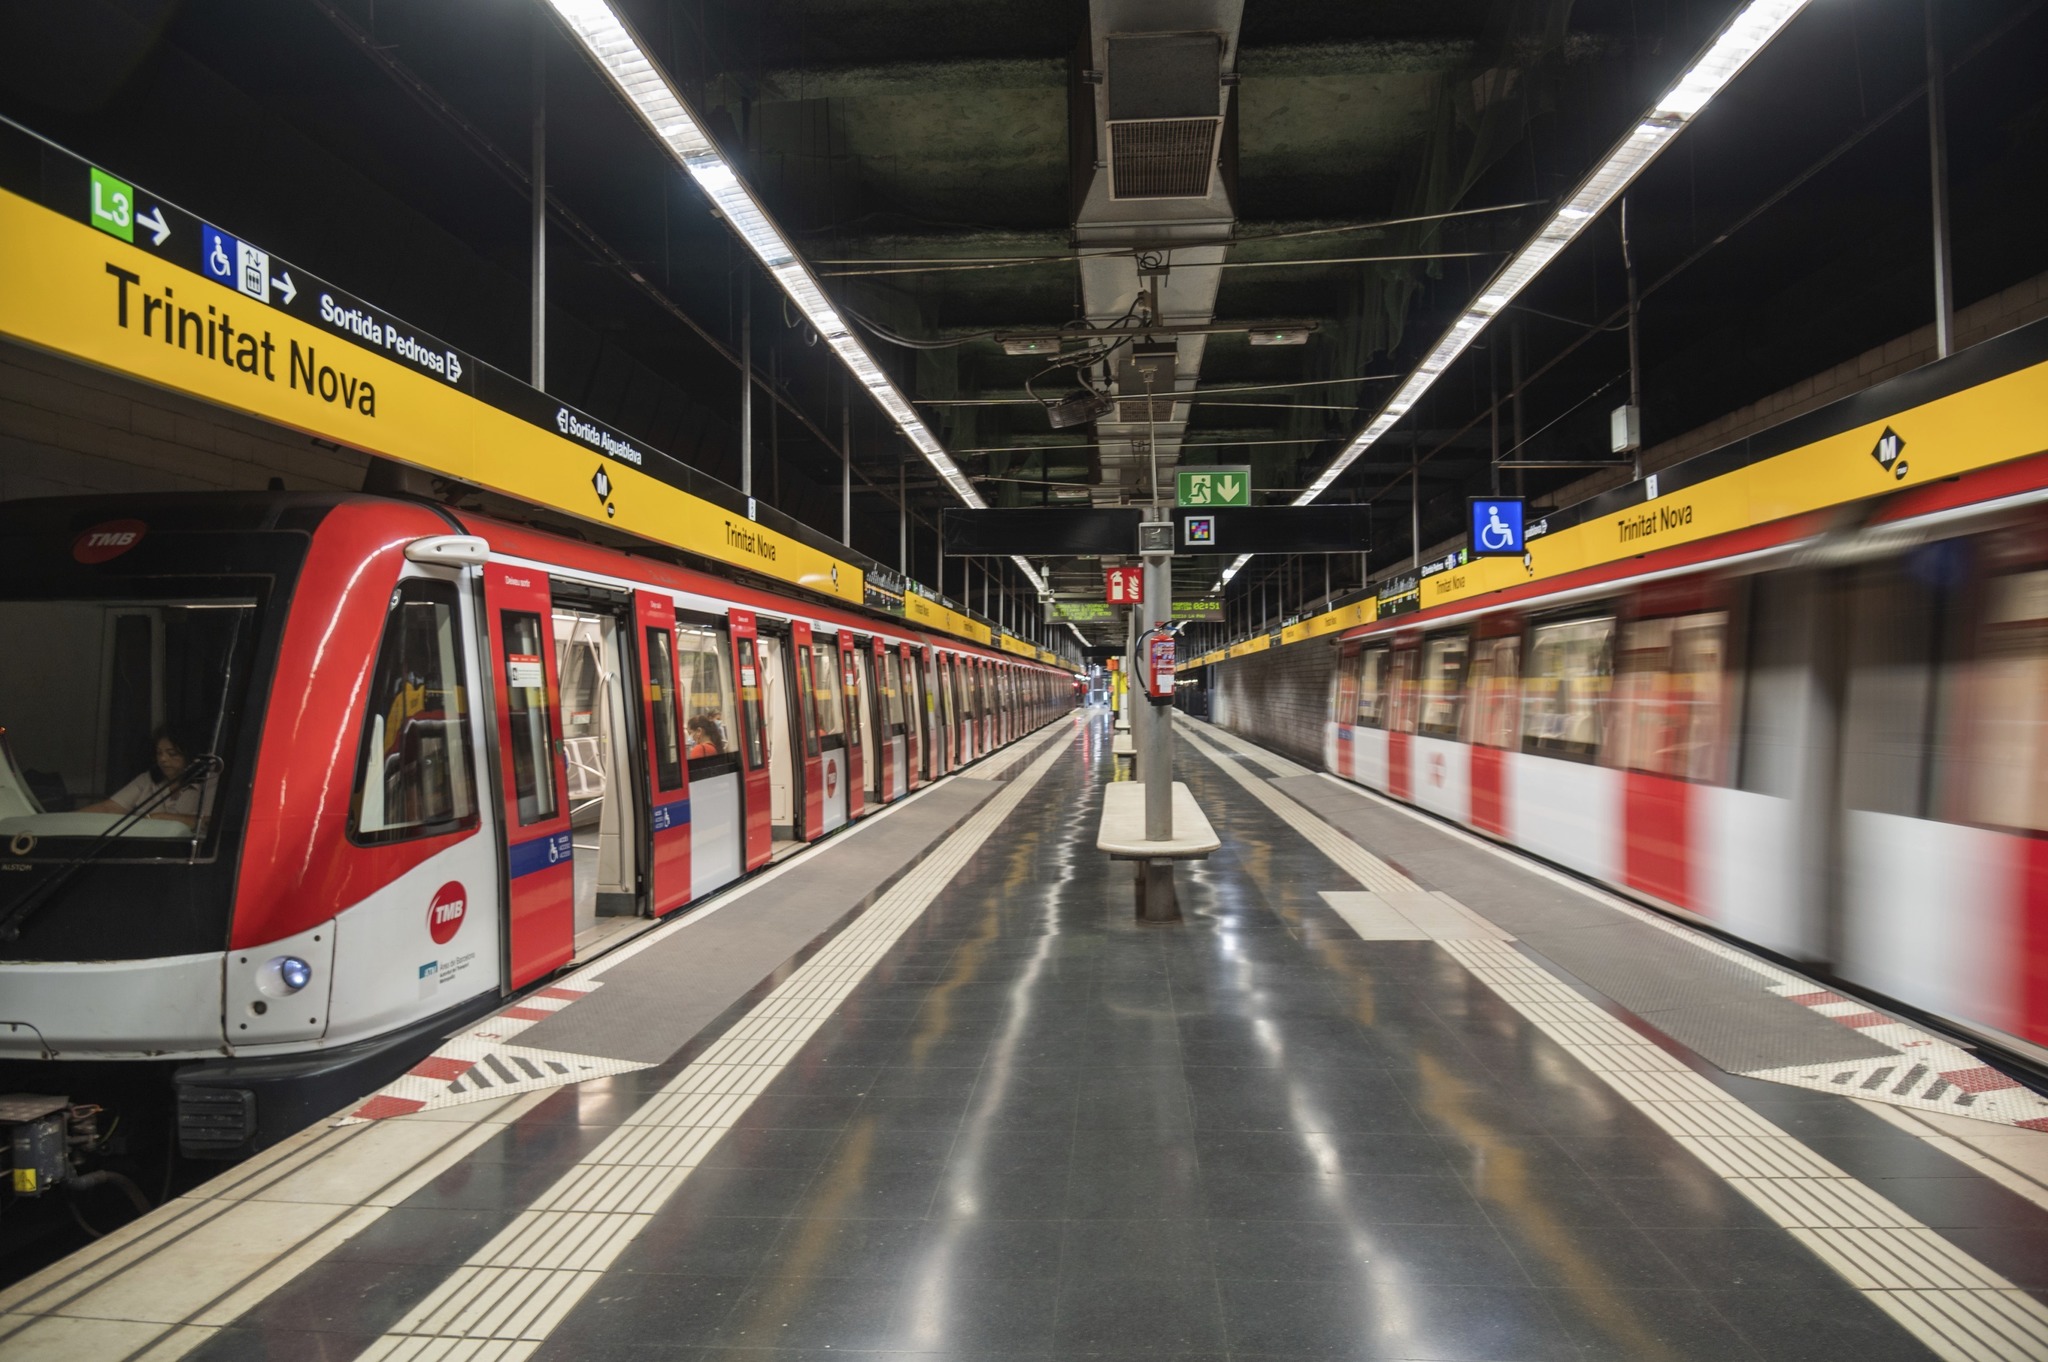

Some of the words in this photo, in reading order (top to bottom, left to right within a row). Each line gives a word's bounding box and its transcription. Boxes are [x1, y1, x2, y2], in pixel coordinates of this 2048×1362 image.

[94, 181, 130, 227] L3
[105, 261, 275, 382] Trinitat
[290, 338, 376, 418] Nova
[320, 293, 383, 345] Sortida
[385, 324, 445, 374] Pedrosa
[569, 415, 601, 446] Sortida
[601, 431, 642, 466] Aiguablava
[1880, 435, 1897, 463] M
[596, 472, 608, 496] M
[88, 532, 137, 547] TMB
[725, 520, 756, 554] Trinitat
[757, 533, 776, 561] Nova
[1618, 511, 1657, 543] Trinitat
[1660, 504, 1693, 532] Nova
[435, 899, 464, 924] TMB
